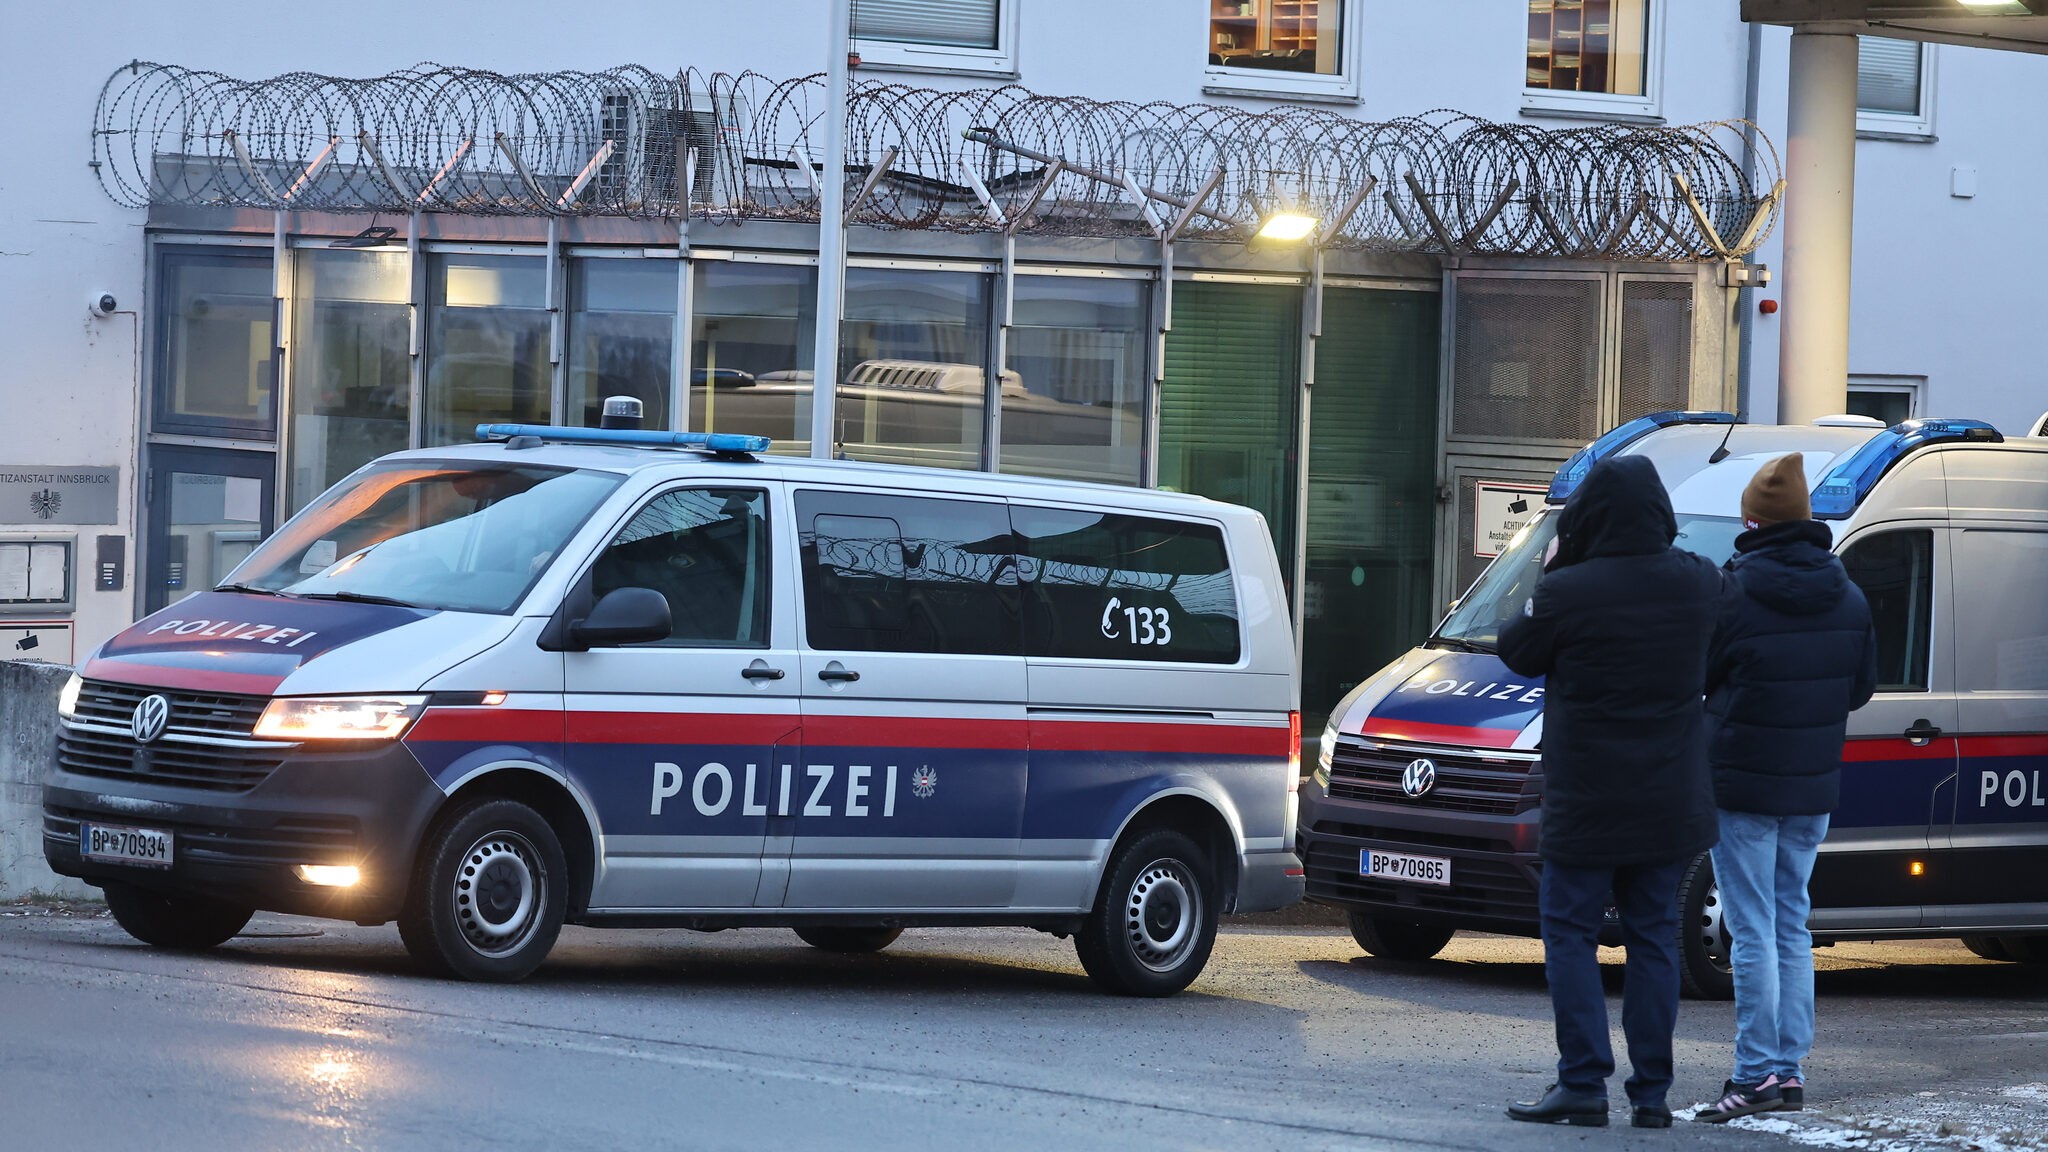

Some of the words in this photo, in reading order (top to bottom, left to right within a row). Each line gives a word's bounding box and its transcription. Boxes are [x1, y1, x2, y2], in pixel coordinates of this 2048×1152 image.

[56, 474, 110, 484] INNSBRUCK
[147, 619, 318, 648] POLIZEI
[1123, 606, 1172, 646] 133
[650, 762, 898, 817] POLIZEI
[1980, 769, 2046, 808] POL
[120, 832, 166, 859] 70934
[1400, 857, 1443, 880] 70965
